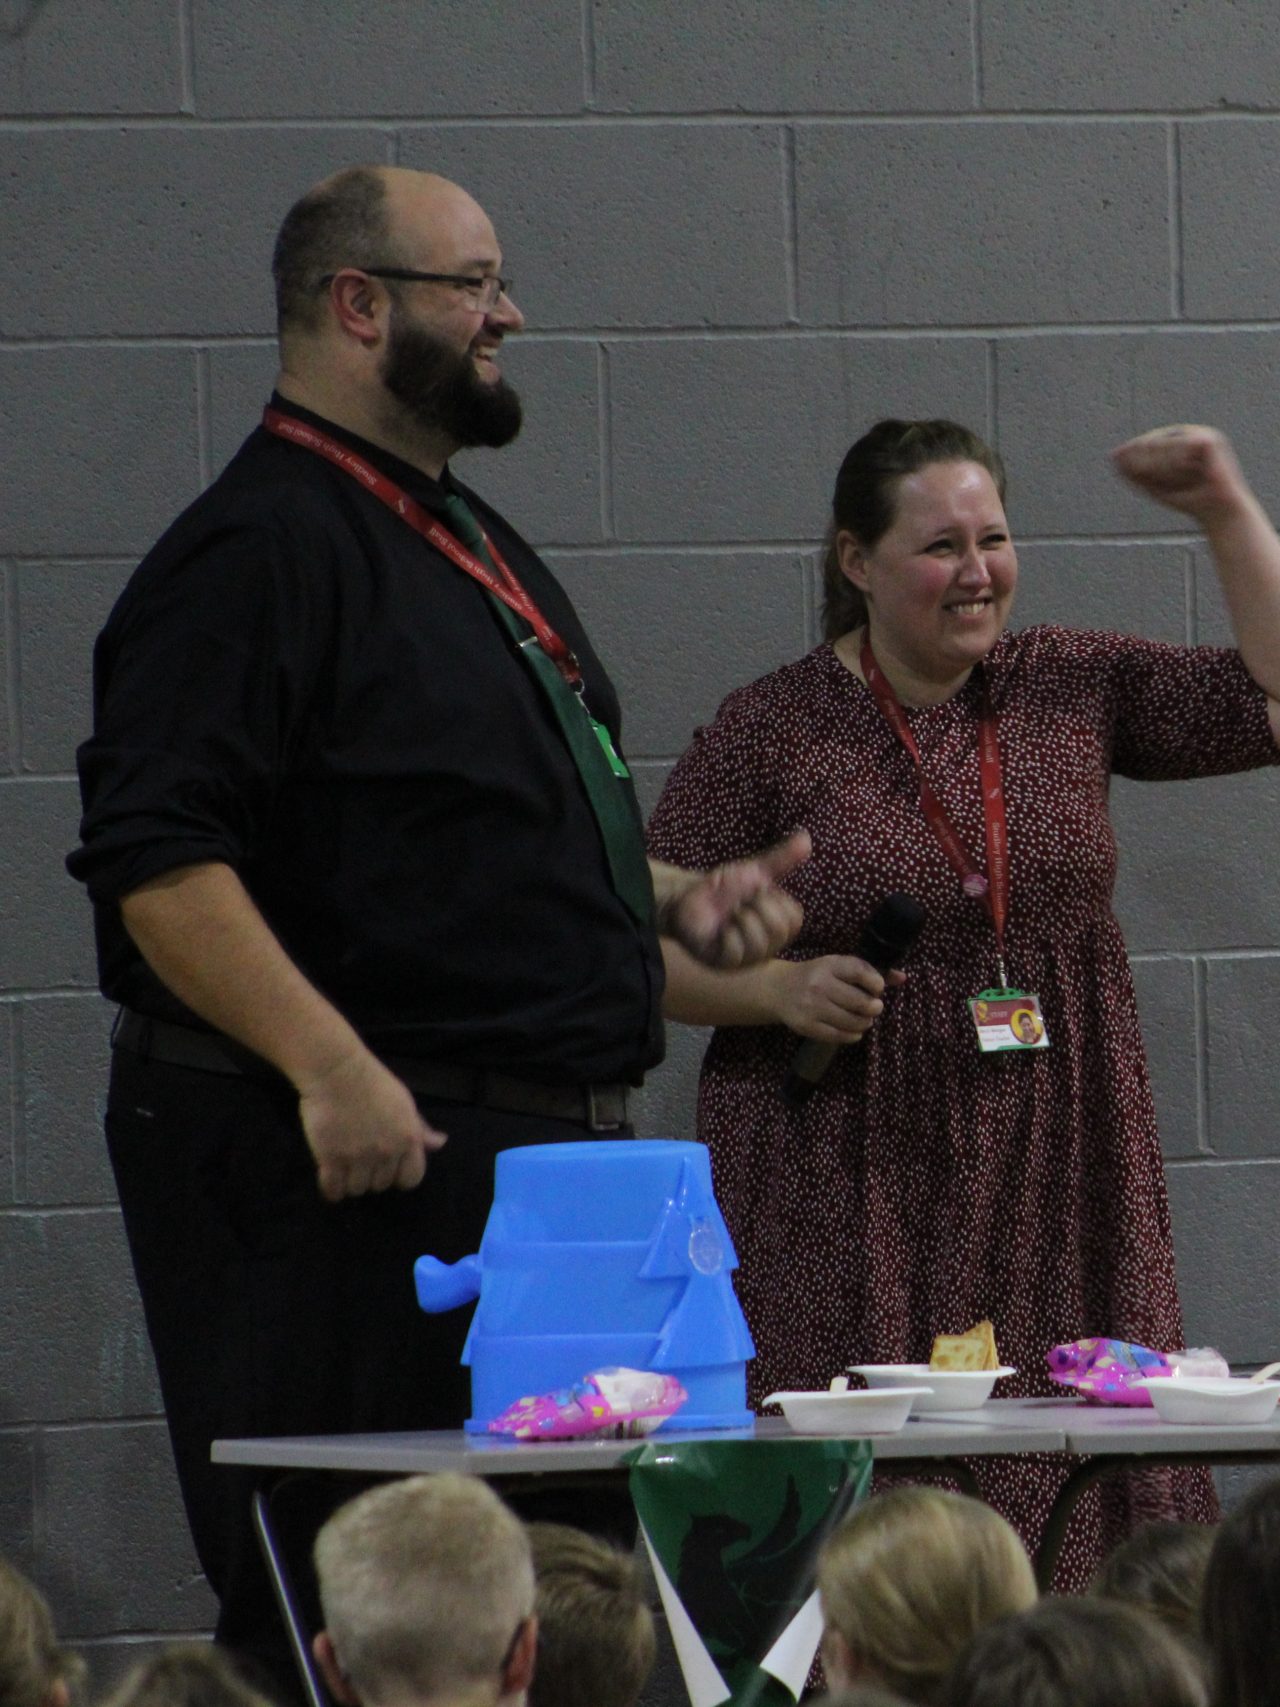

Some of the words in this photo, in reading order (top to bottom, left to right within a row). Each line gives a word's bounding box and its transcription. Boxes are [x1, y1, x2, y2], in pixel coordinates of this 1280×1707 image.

[294, 429, 322, 448] School
[322, 442, 344, 461] High
[344, 456, 377, 486] Studley
[447, 543, 474, 569] School
[994, 857, 1003, 880] High
